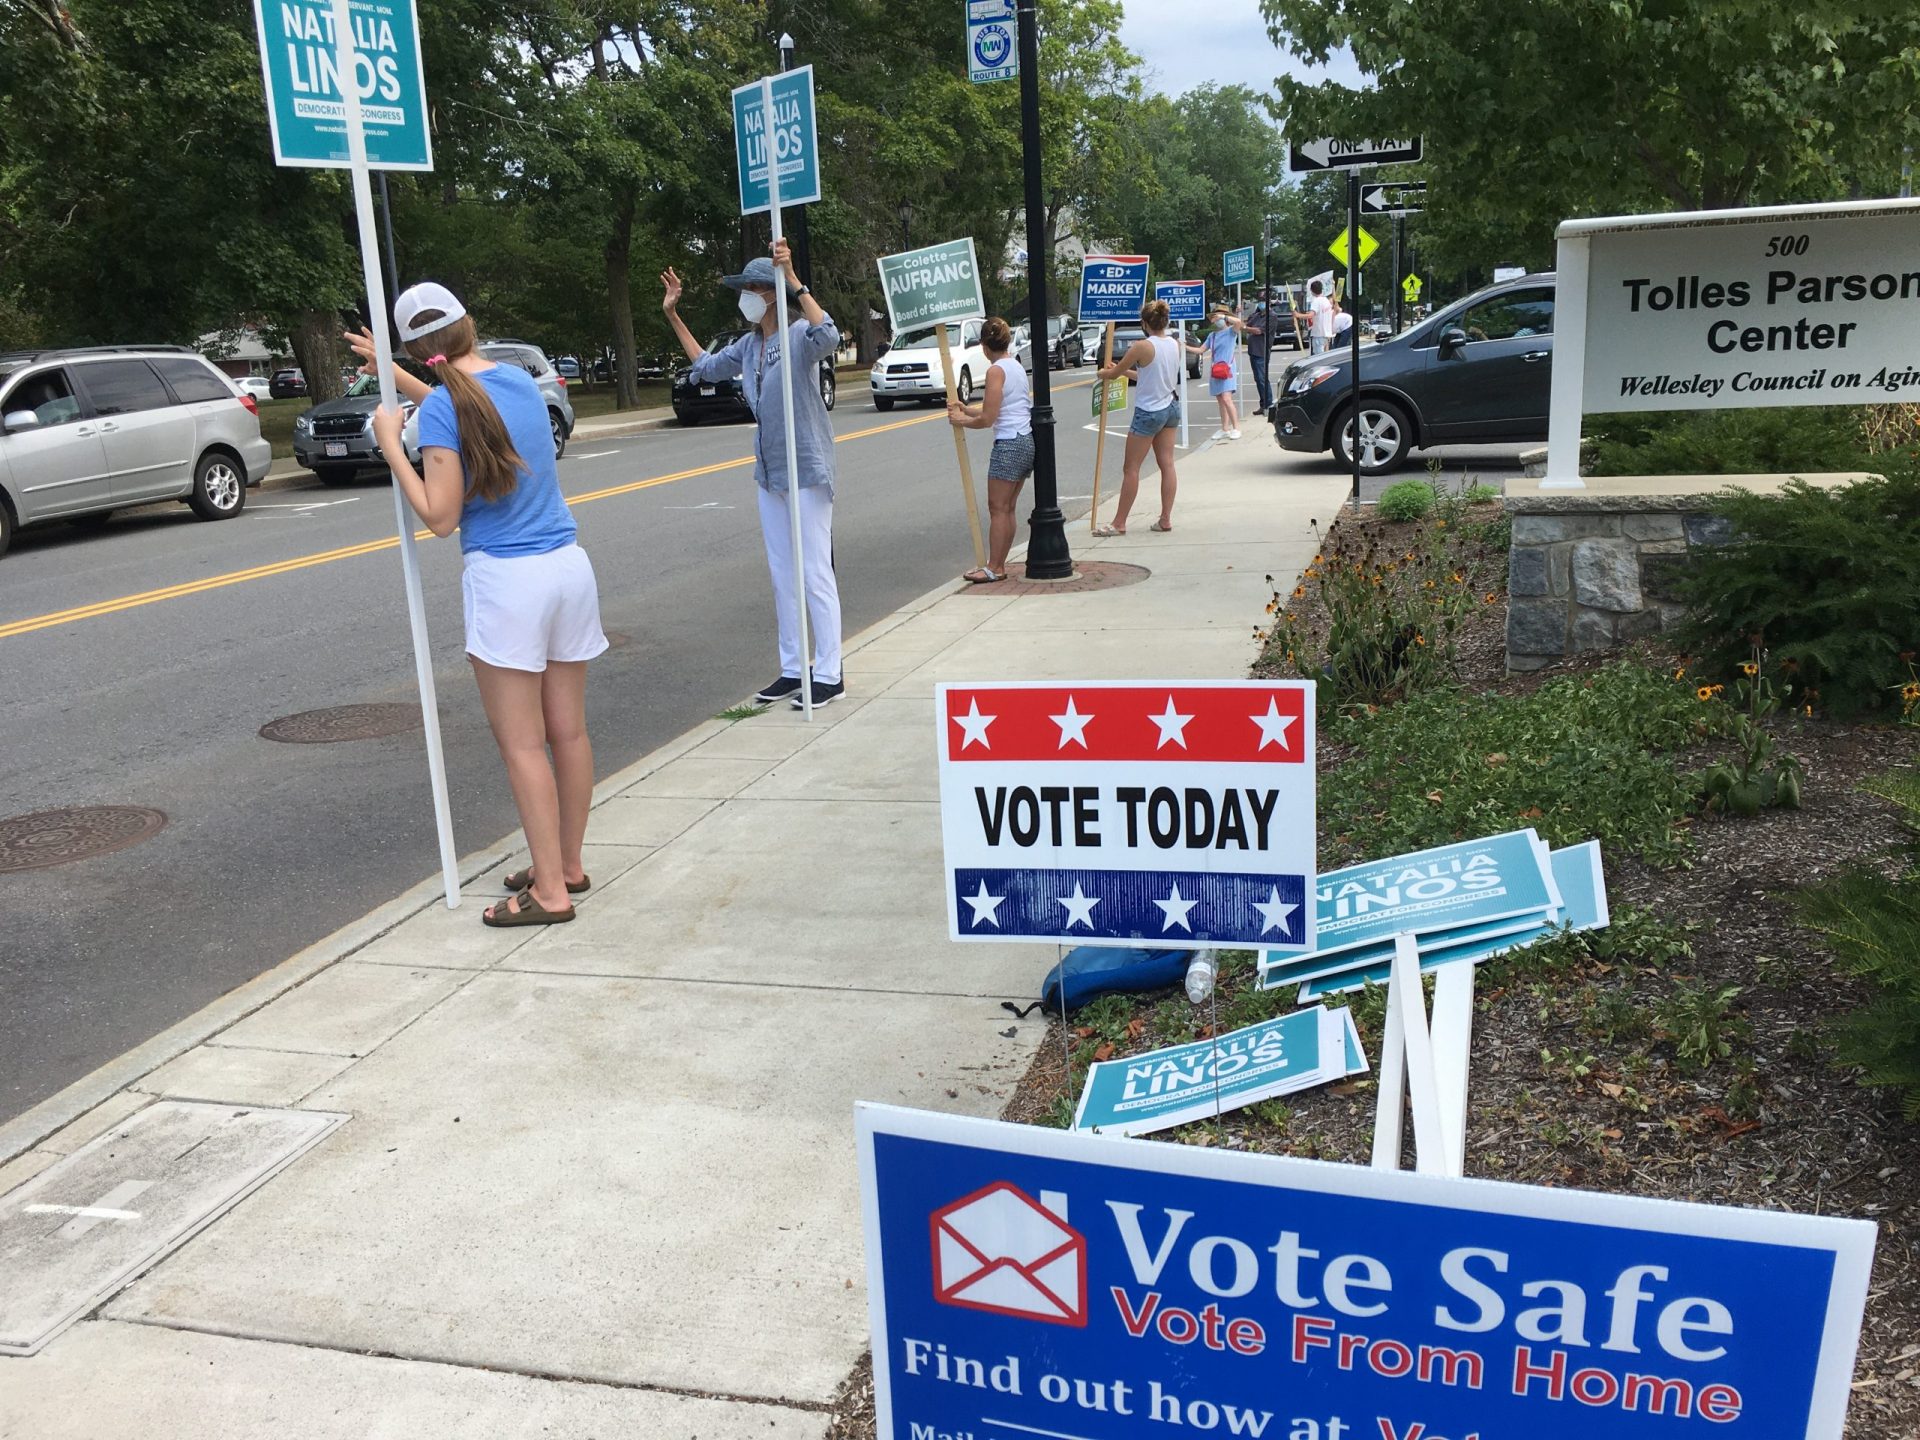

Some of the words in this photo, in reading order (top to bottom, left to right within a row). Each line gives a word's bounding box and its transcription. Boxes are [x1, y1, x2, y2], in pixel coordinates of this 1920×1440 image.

[976, 27, 989, 44] BUS
[990, 25, 1009, 40] STOP
[974, 71, 1000, 80] ROUTE
[1005, 67, 1011, 77] 8
[297, 103, 341, 116] DEMOCRAT
[1765, 234, 1810, 257] 500
[903, 252, 948, 269] Colette
[1106, 266, 1124, 278] ED
[1228, 261, 1249, 273] LINOS
[890, 260, 972, 297] AUFRANC
[1087, 283, 1142, 295] MARKEY
[1173, 287, 1186, 295] ED
[924, 290, 937, 300] for
[1096, 299, 1128, 308] SENATE
[1622, 275, 1751, 313] Tolles
[896, 307, 918, 322] Board
[919, 304, 928, 316] of
[929, 297, 977, 314] Selectmen
[1707, 316, 1857, 354] Center
[1620, 373, 1725, 398] Wellesley
[1731, 368, 1827, 392] Council
[1831, 373, 1862, 389] on
[974, 785, 1102, 848] VOTE
[1116, 785, 1280, 851] TODAY
[1389, 904, 1417, 915] FOR
[1421, 889, 1500, 908] CONGRESS
[1126, 1030, 1285, 1082] NATALIA
[1122, 1043, 1283, 1100] LINOS
[1122, 1091, 1186, 1109] DEMOCRAT
[1190, 1083, 1214, 1093] FOR
[1219, 1063, 1279, 1085] CONGRESS
[1104, 1200, 1393, 1318] Vote
[1434, 1246, 1734, 1362] Safe
[1110, 1286, 1266, 1355] Vote
[1292, 1313, 1484, 1390] From
[1512, 1346, 1743, 1424] Home
[902, 1337, 1023, 1396] Find
[1039, 1374, 1133, 1416] out
[1147, 1381, 1274, 1440] how
